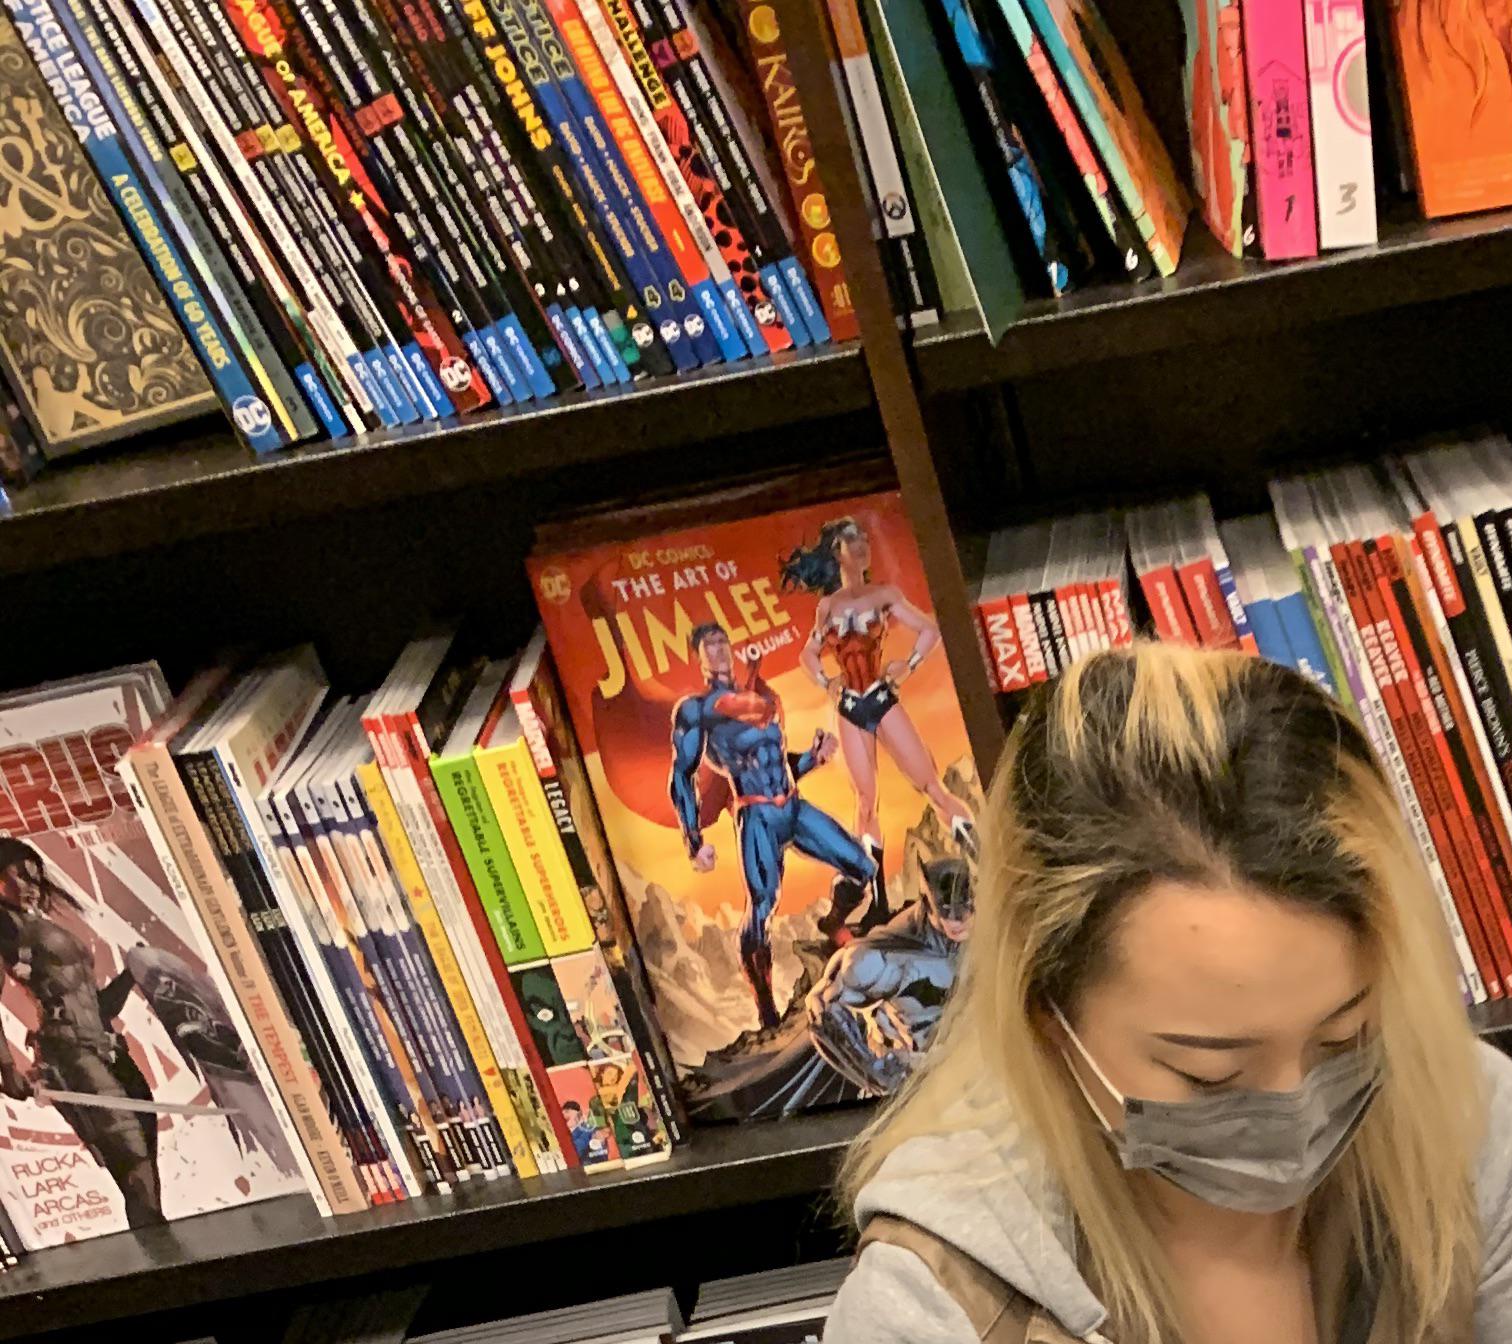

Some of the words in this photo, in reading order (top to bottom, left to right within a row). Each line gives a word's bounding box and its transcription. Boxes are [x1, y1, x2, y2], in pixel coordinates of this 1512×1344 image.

[13, 14, 94, 145] AMERICA
[54, 49, 117, 142] LEAGUE
[483, 39, 554, 153] JOHNS
[757, 53, 815, 186] KAIROS
[287, 83, 353, 186] AMERICA
[1335, 183, 1358, 216] 3
[119, 183, 182, 282] CELEBRATION
[172, 279, 193, 302] OF
[194, 321, 231, 370] YEARS
[611, 572, 667, 603] THE
[672, 564, 710, 591] ART
[715, 559, 739, 581] OF
[591, 598, 694, 700] JIM
[703, 575, 792, 647] LEE
[734, 632, 793, 665] VOLUME
[986, 612, 1026, 686] MAX
[1011, 602, 1042, 678] MARVEL
[1360, 622, 1392, 690] REAVER
[1376, 618, 1408, 684] REAVER
[1466, 647, 1489, 695] PIERCE
[1480, 695, 1512, 759] BROWN'S
[512, 698, 556, 772] MARVEL
[542, 779, 577, 838] LEGACY
[448, 769, 491, 855] REGRETTABLE
[482, 856, 527, 952] SUPERVILLAINS
[494, 760, 537, 849] REGRETTABLE
[527, 851, 572, 943] SUPERHEROES
[248, 991, 269, 1022] THE
[264, 1024, 296, 1087] TEMPEST
[11, 1151, 89, 1180] RUCKA
[21, 1174, 78, 1199] LARK
[33, 1190, 100, 1218] ARCAS
